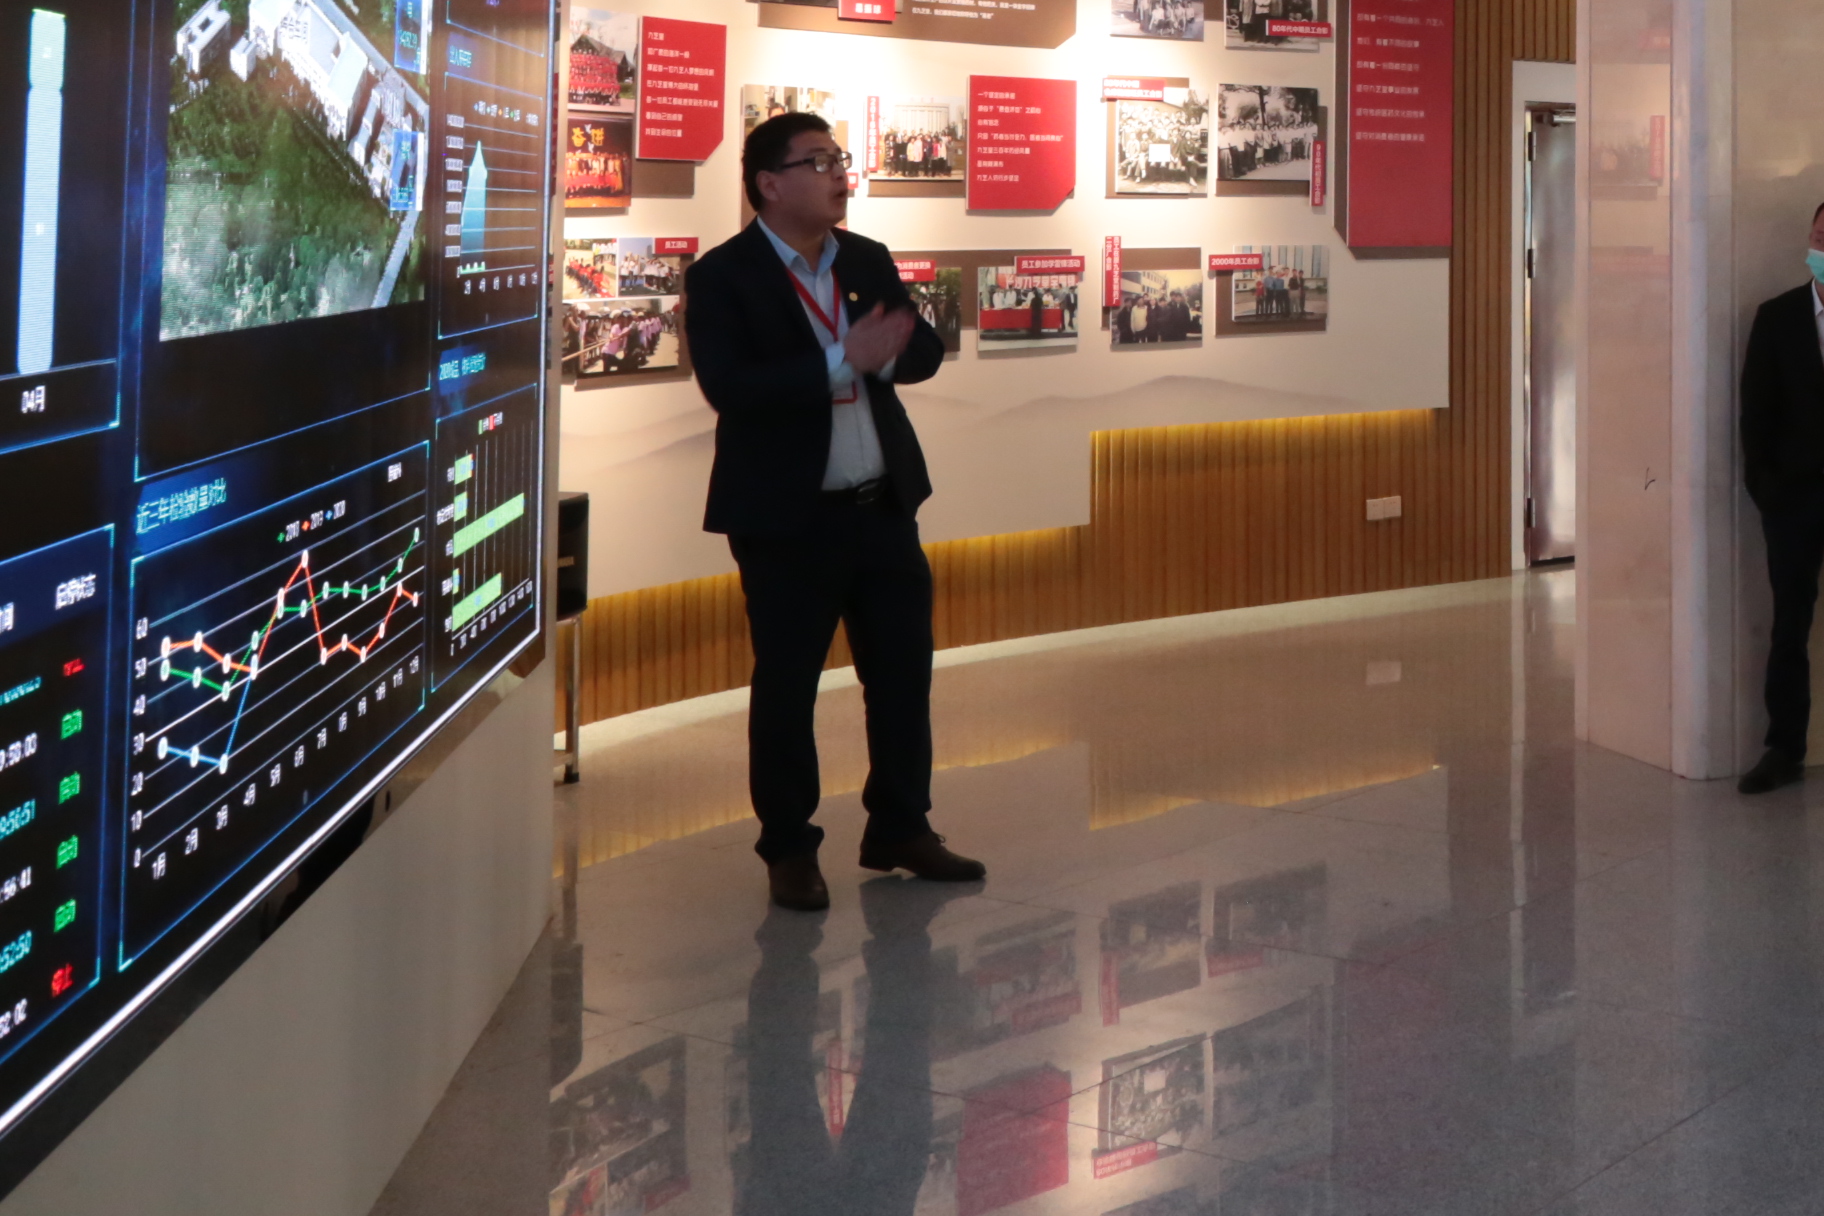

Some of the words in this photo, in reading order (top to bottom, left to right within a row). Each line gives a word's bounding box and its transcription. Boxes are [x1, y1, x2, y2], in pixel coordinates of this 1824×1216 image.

[136, 478, 228, 535] 近三年检验数量对比
[135, 617, 148, 640] 60
[134, 656, 147, 679] 50
[133, 694, 146, 715] 40
[133, 732, 145, 755] 30
[131, 772, 144, 796] 20
[130, 810, 143, 832] 10
